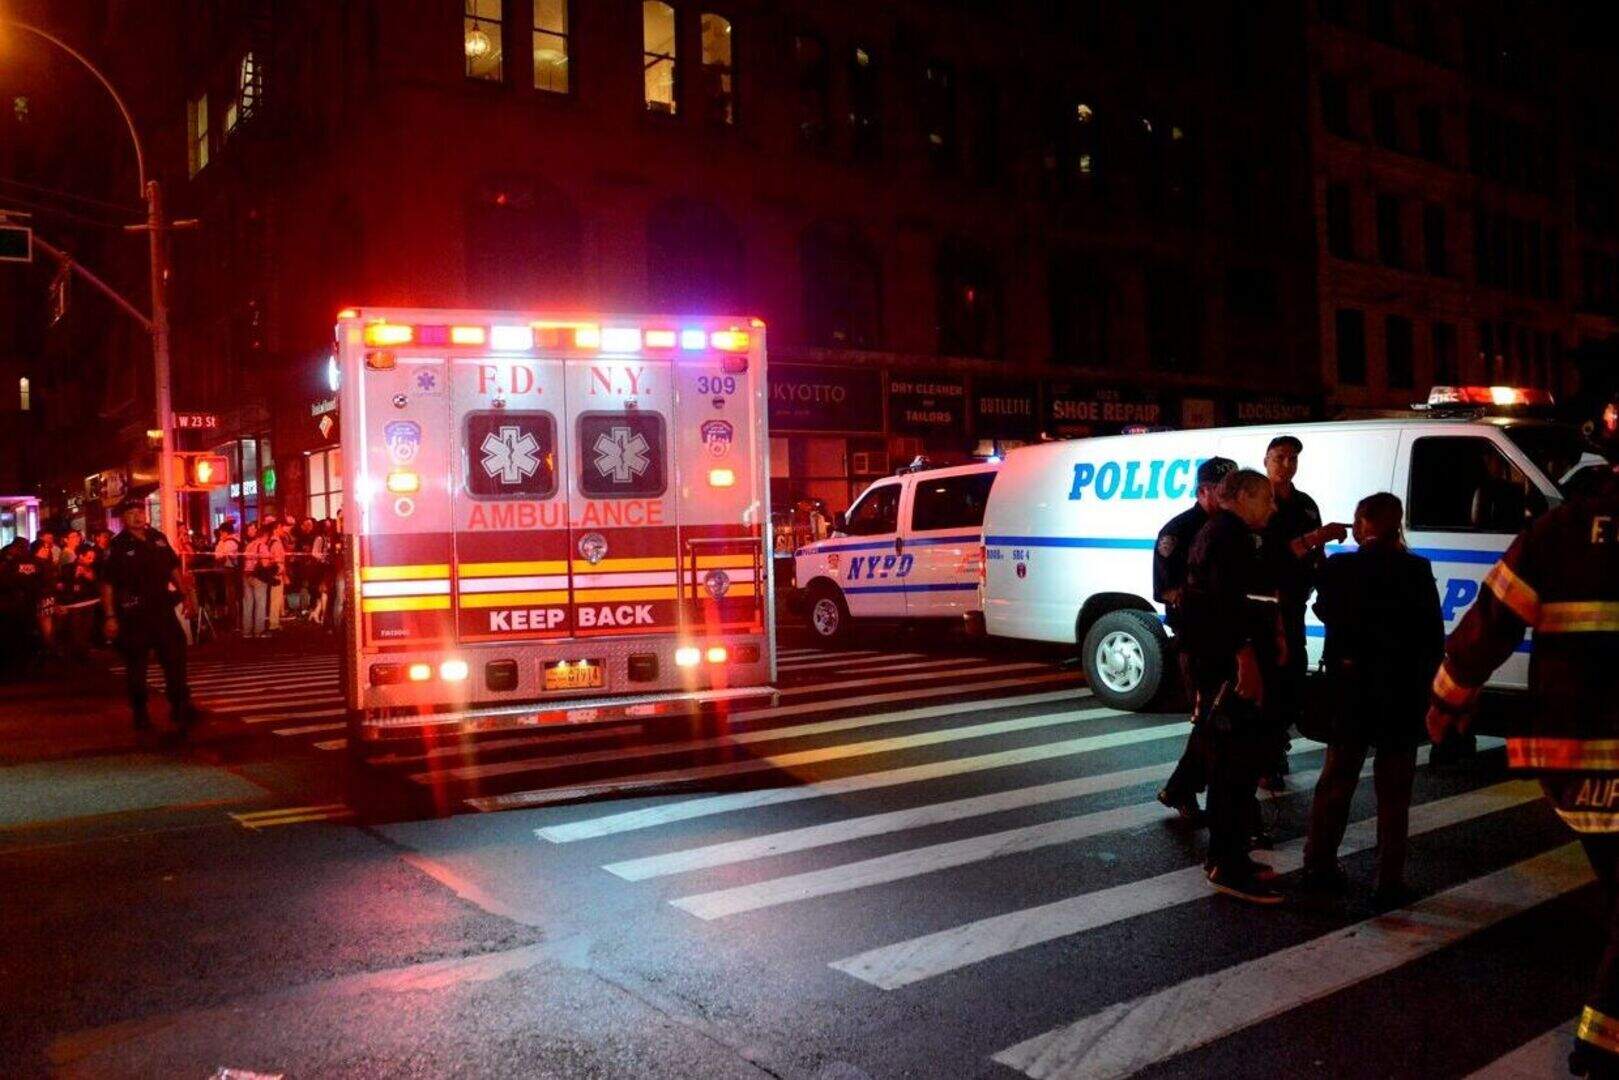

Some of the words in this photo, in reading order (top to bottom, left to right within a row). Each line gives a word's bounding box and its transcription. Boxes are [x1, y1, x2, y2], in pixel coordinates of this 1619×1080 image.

[477, 365, 544, 395] F.D.
[588, 366, 652, 395] N.Y.
[697, 376, 736, 394] 309
[766, 383, 846, 402] KYOTTO
[179, 416, 188, 427] W
[191, 415, 202, 427] 23
[1052, 400, 1099, 420] SHOE
[1103, 402, 1160, 422] REPAIR
[467, 501, 665, 529] AMBULANCE
[847, 553, 914, 580] NYPD
[490, 609, 565, 632] KEEP
[578, 605, 655, 627] BACK
